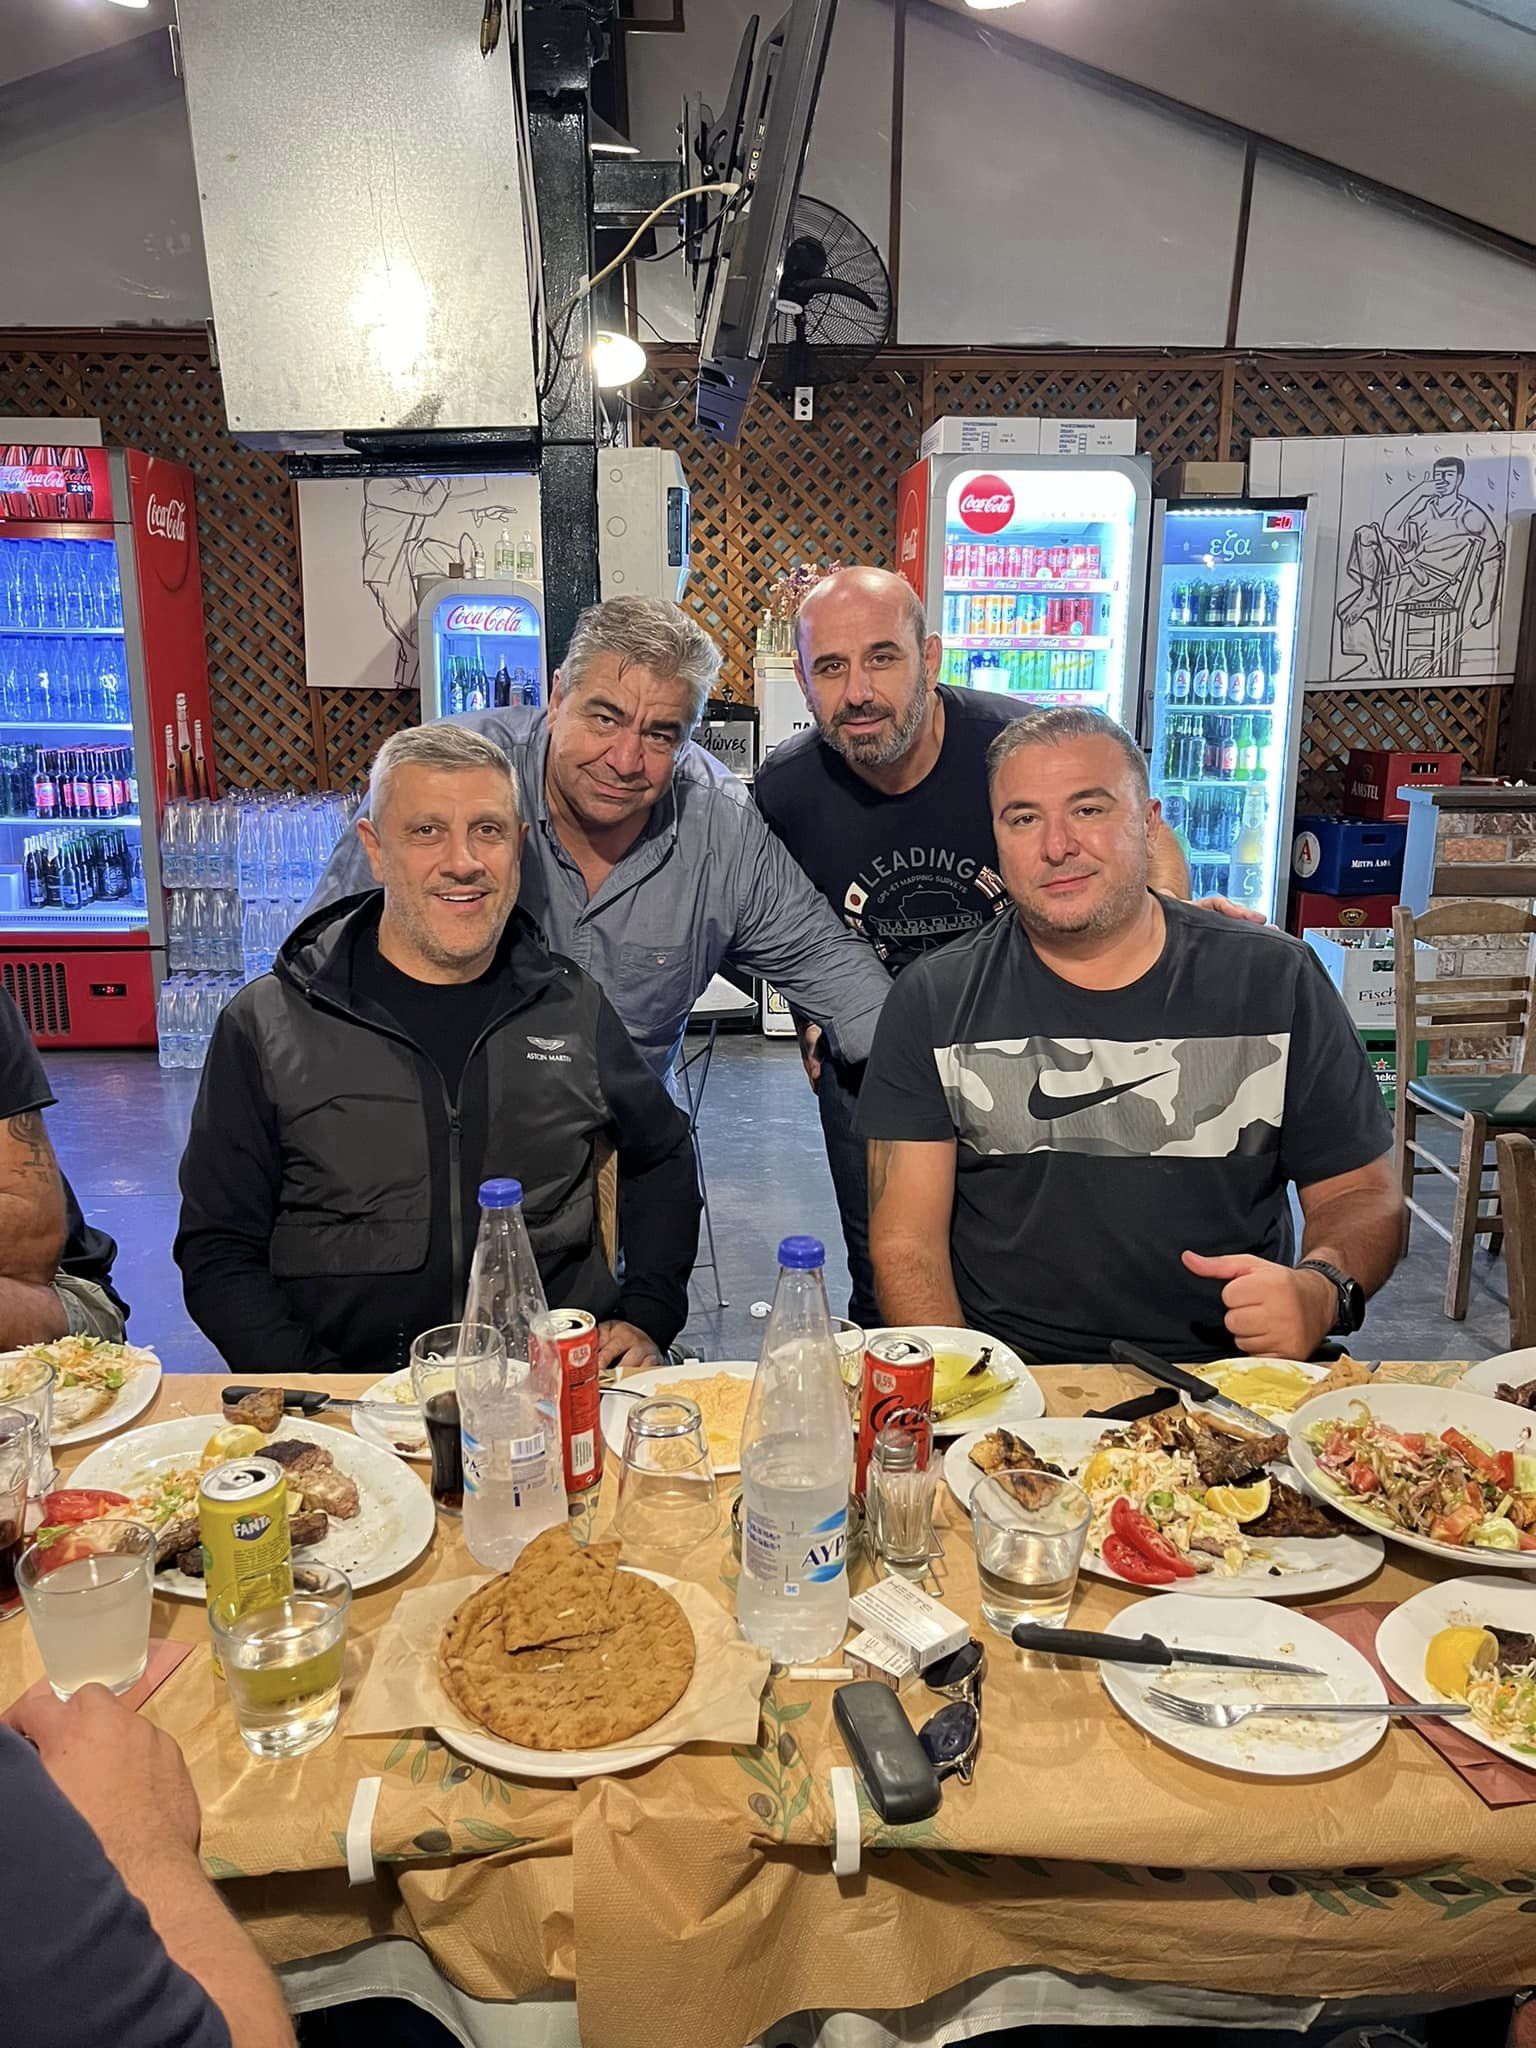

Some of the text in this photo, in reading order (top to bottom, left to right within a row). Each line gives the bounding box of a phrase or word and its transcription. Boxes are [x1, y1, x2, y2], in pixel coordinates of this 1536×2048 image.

[960, 494, 1013, 514] Coca-Cola
[447, 605, 526, 632] Coca-Cola
[1351, 781, 1379, 800] AMSTEL
[859, 847, 976, 888] LEADING
[900, 874, 934, 887] MAPPING
[1359, 986, 1397, 1001] Fisch
[233, 1514, 272, 1537] FANTA
[801, 1533, 846, 1568] ΑΥΡ
